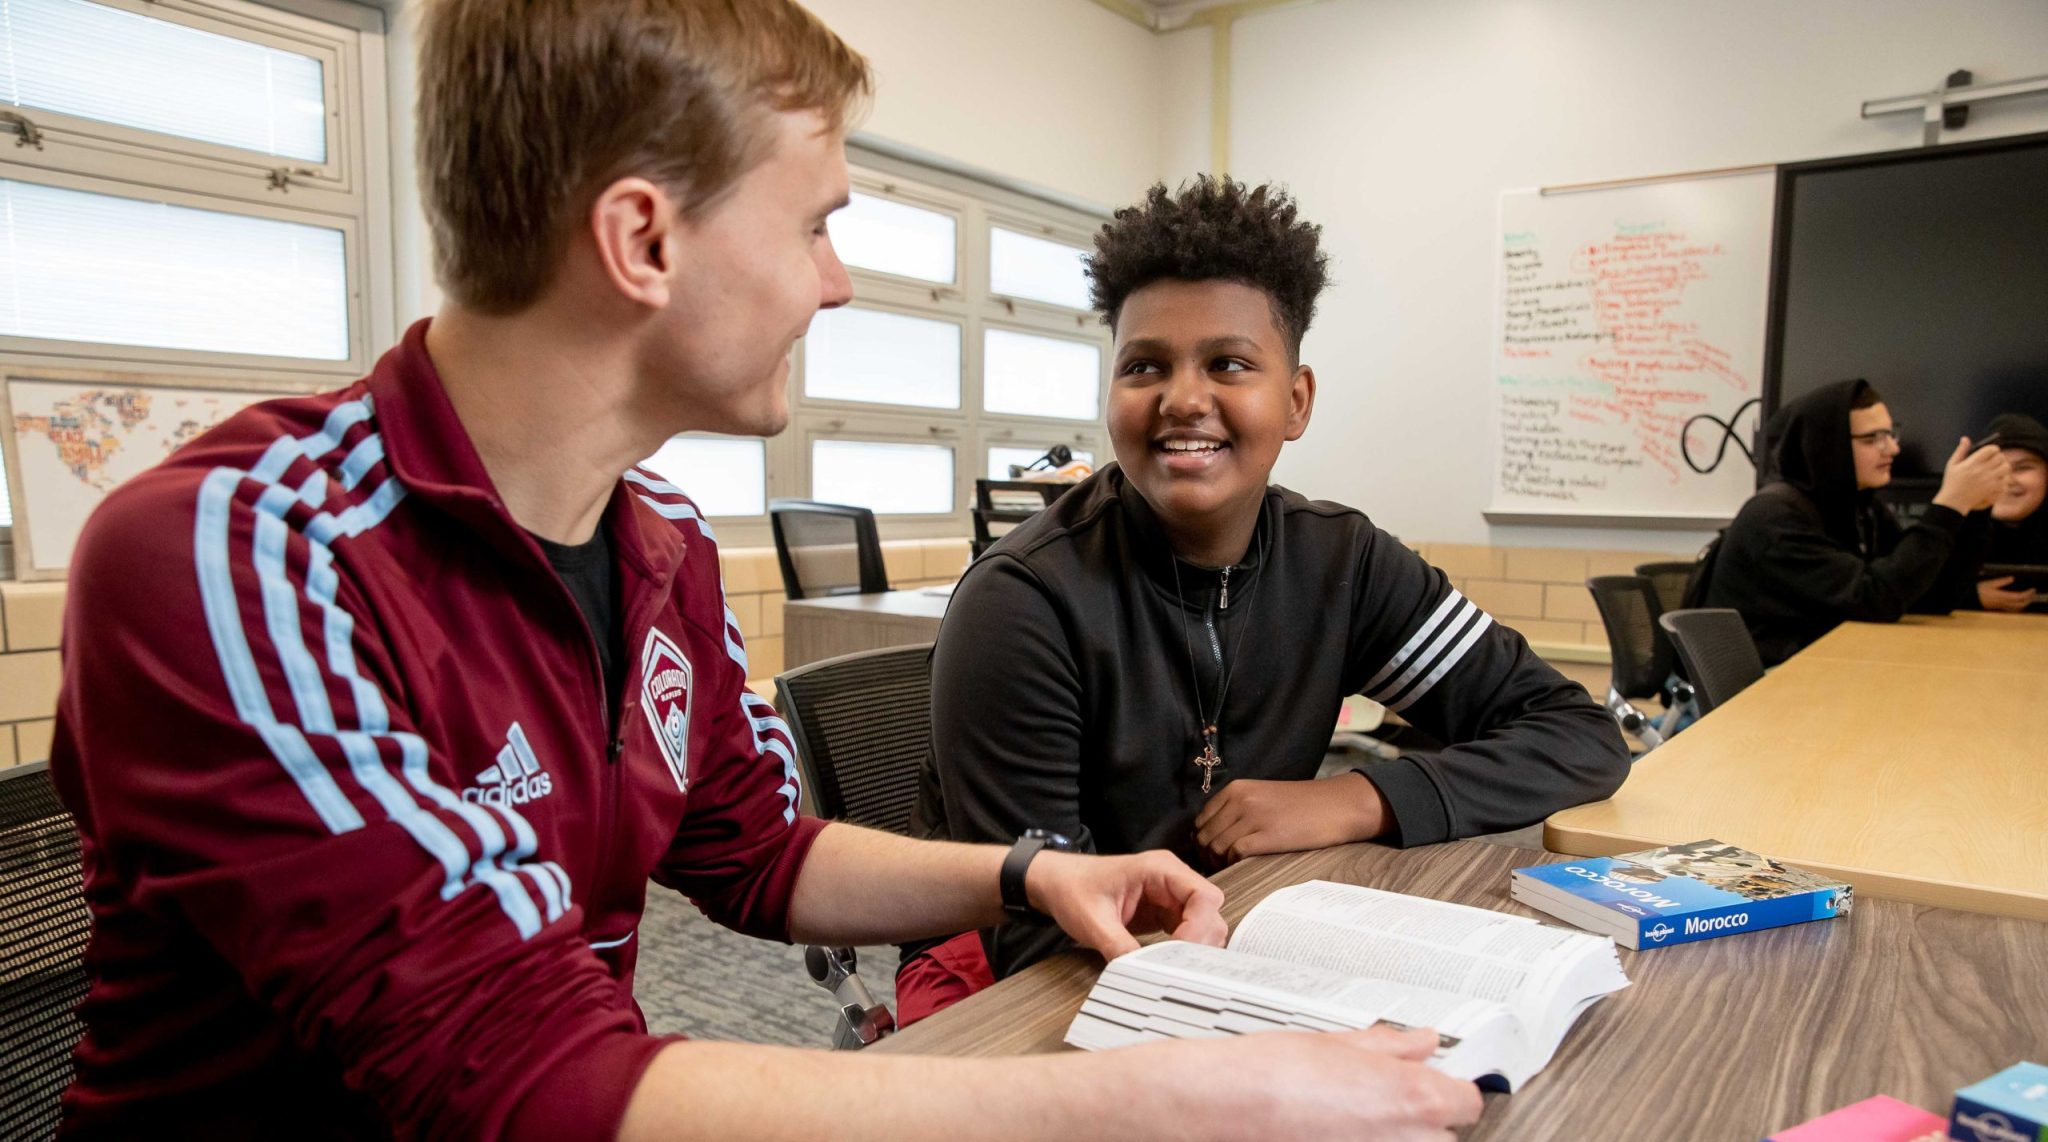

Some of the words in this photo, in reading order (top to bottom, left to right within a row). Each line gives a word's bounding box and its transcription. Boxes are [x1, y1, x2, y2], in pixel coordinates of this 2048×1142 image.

[651, 669, 687, 699] COLORADO
[661, 689, 682, 702] RAPIDS
[462, 772, 553, 808] adidas
[1684, 912, 1749, 935] Morocco
